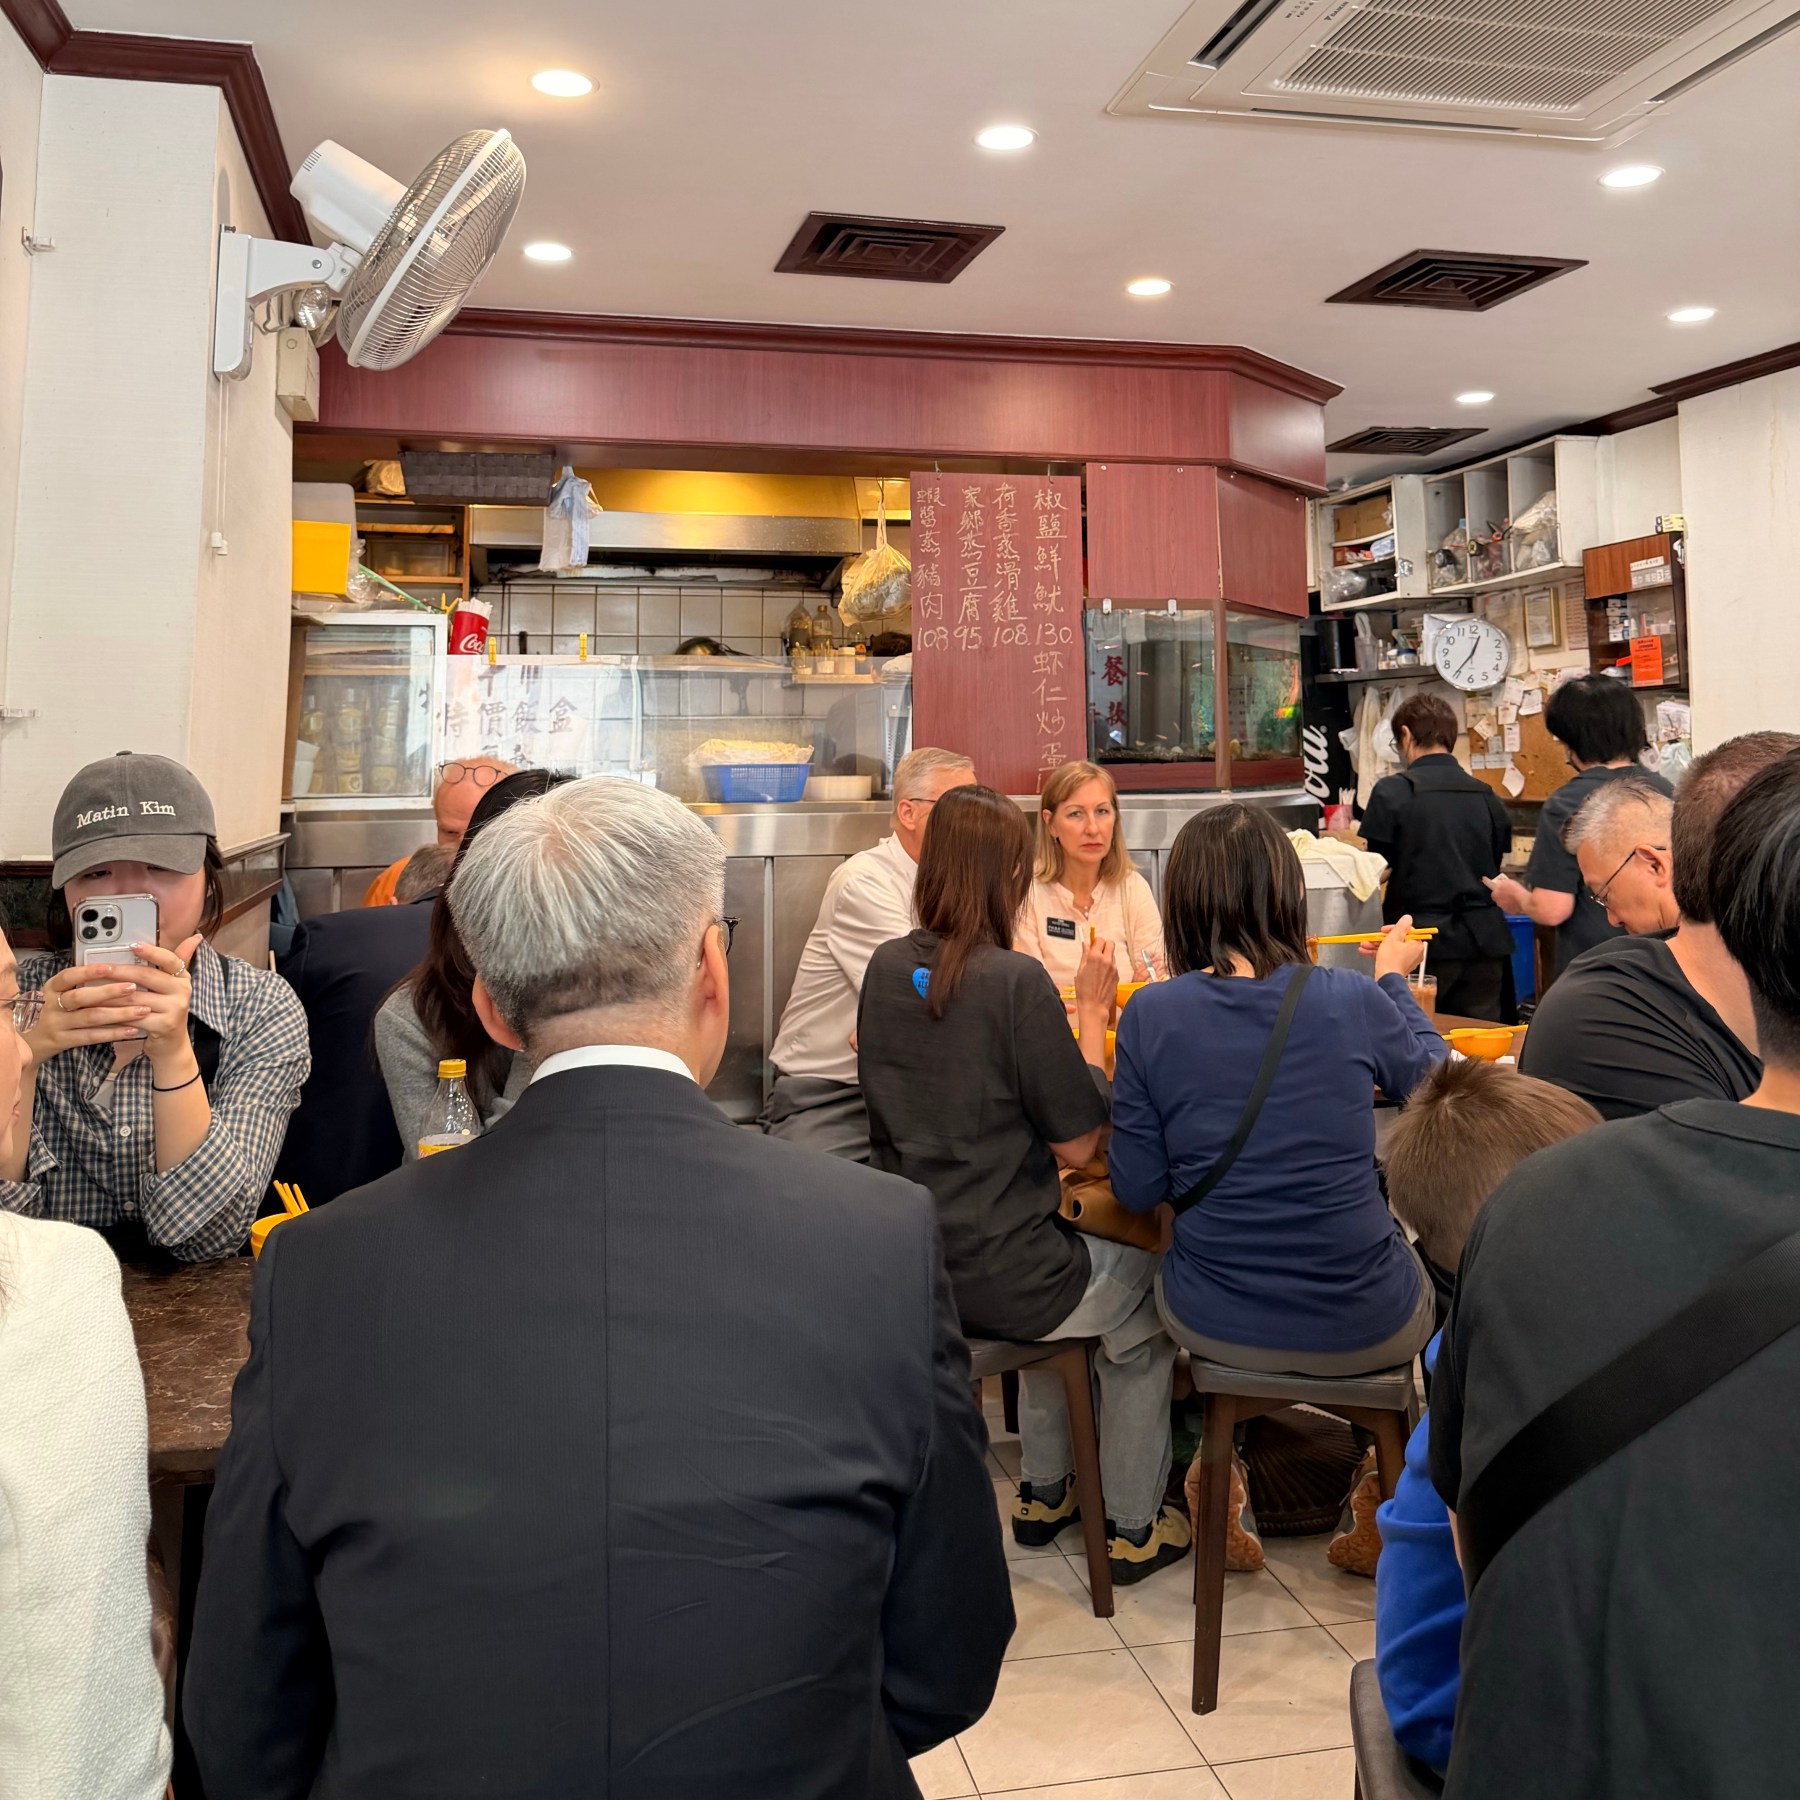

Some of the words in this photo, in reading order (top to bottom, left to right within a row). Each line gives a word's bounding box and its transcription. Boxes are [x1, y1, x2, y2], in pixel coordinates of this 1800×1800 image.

[956, 486, 987, 624] 家鄉蒸豆腐
[1457, 627, 1465, 636] 11
[1469, 625, 1478, 635] 12
[1486, 629, 1490, 637] 1
[1446, 636, 1455, 645] 10
[1494, 639, 1501, 648] 2
[1442, 648, 1449, 657] 9
[1496, 652, 1503, 661] 3
[1443, 661, 1451, 669] 8
[1492, 663, 1499, 672] 4
[1467, 674, 1474, 684] 6
[1482, 672, 1489, 681] 5
[76, 805, 130, 829] Matin
[139, 801, 176, 816] Kim
